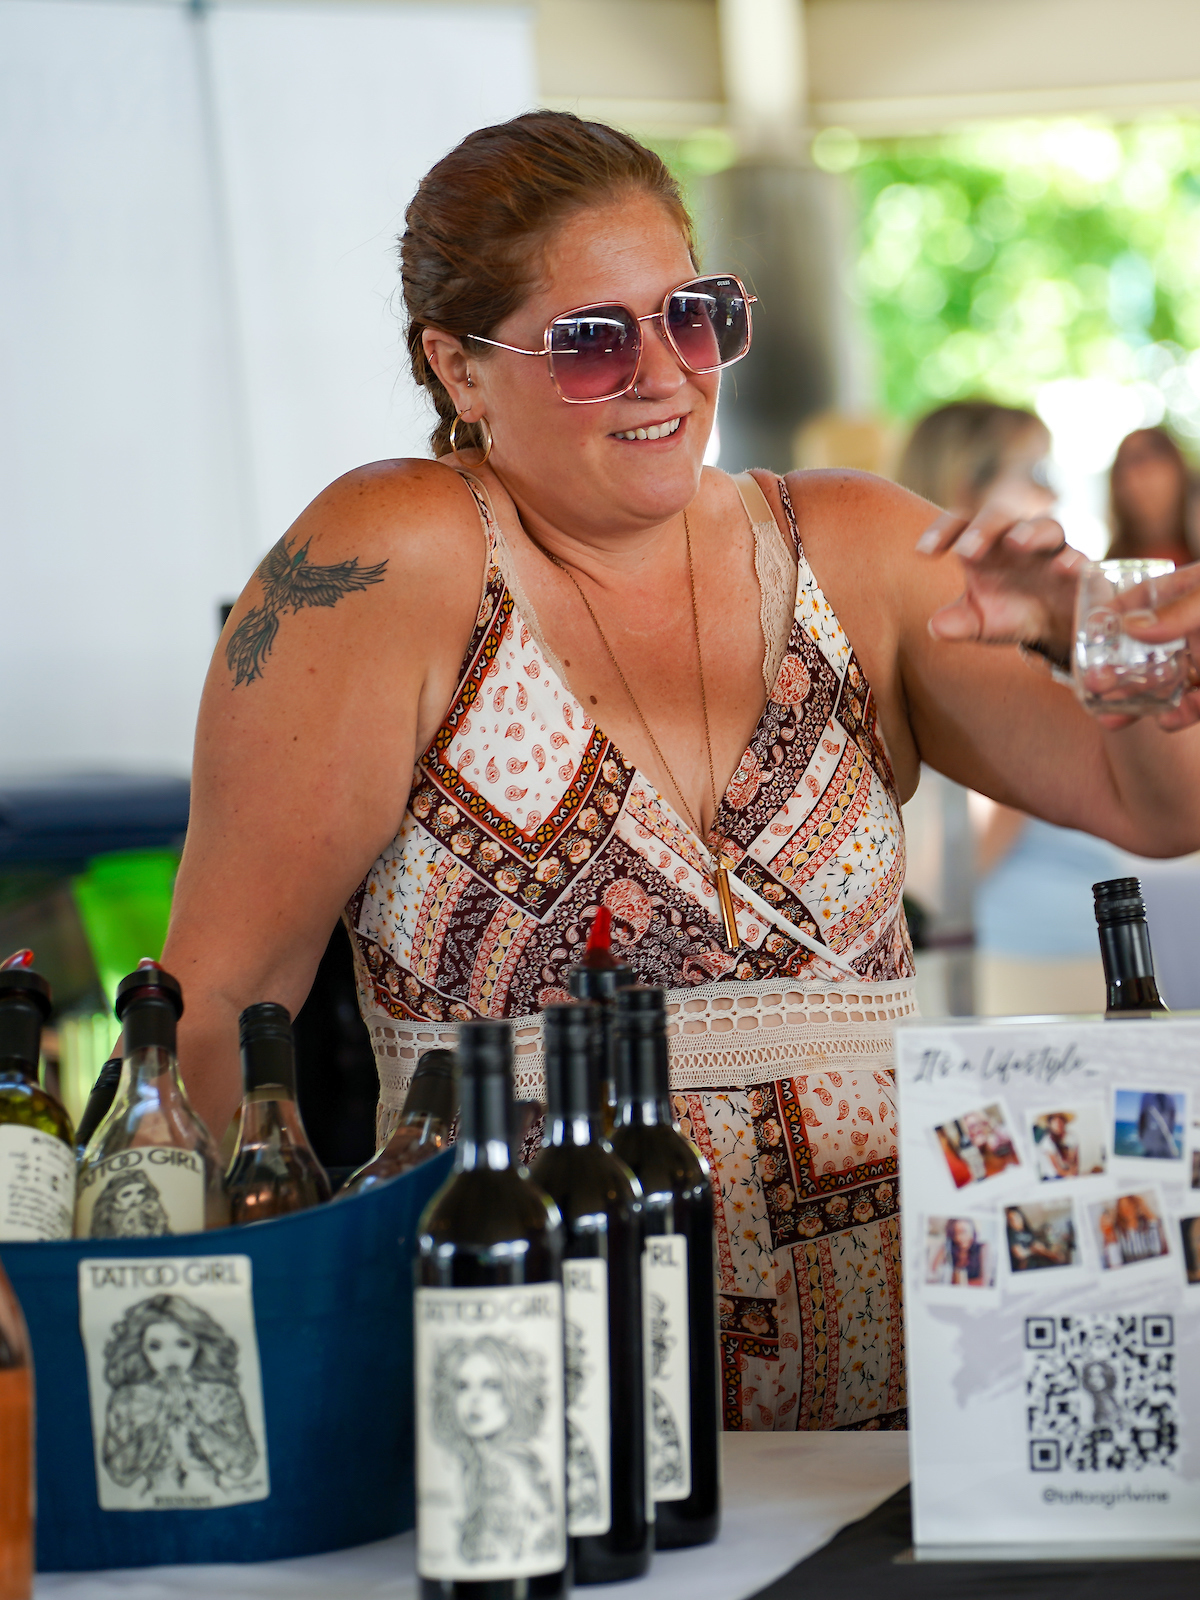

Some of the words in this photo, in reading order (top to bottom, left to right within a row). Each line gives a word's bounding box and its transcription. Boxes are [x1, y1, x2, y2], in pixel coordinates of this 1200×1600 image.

[147, 1148, 201, 1174] GIRL
[88, 1264, 180, 1289] TATTOO
[182, 1259, 242, 1286] GIRL
